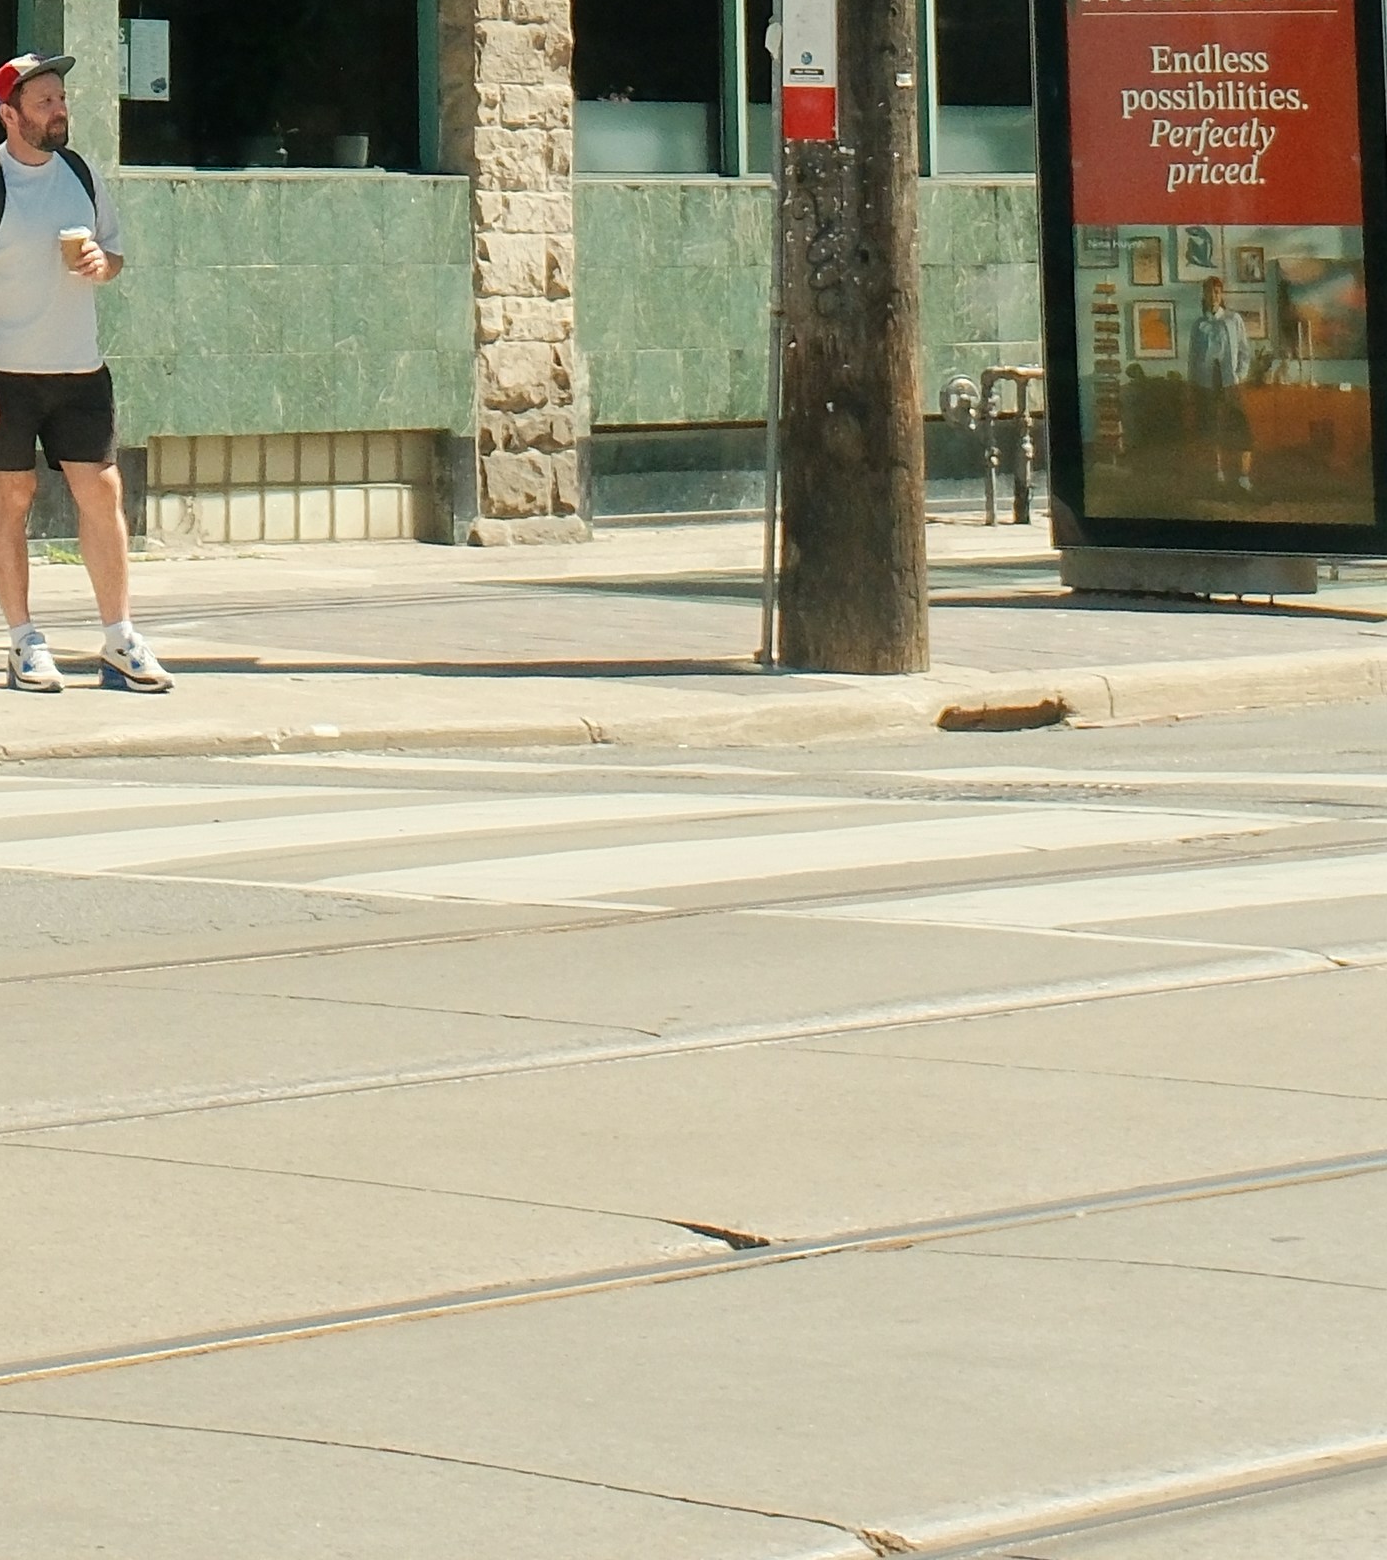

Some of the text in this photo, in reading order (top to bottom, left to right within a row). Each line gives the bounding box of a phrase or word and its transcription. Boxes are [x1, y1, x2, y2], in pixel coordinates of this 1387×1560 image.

[1149, 44, 1270, 74] Endless
[1121, 81, 1309, 119] possibilities.
[1149, 118, 1277, 156] Perfectly
[1167, 155, 1267, 193] priced.
